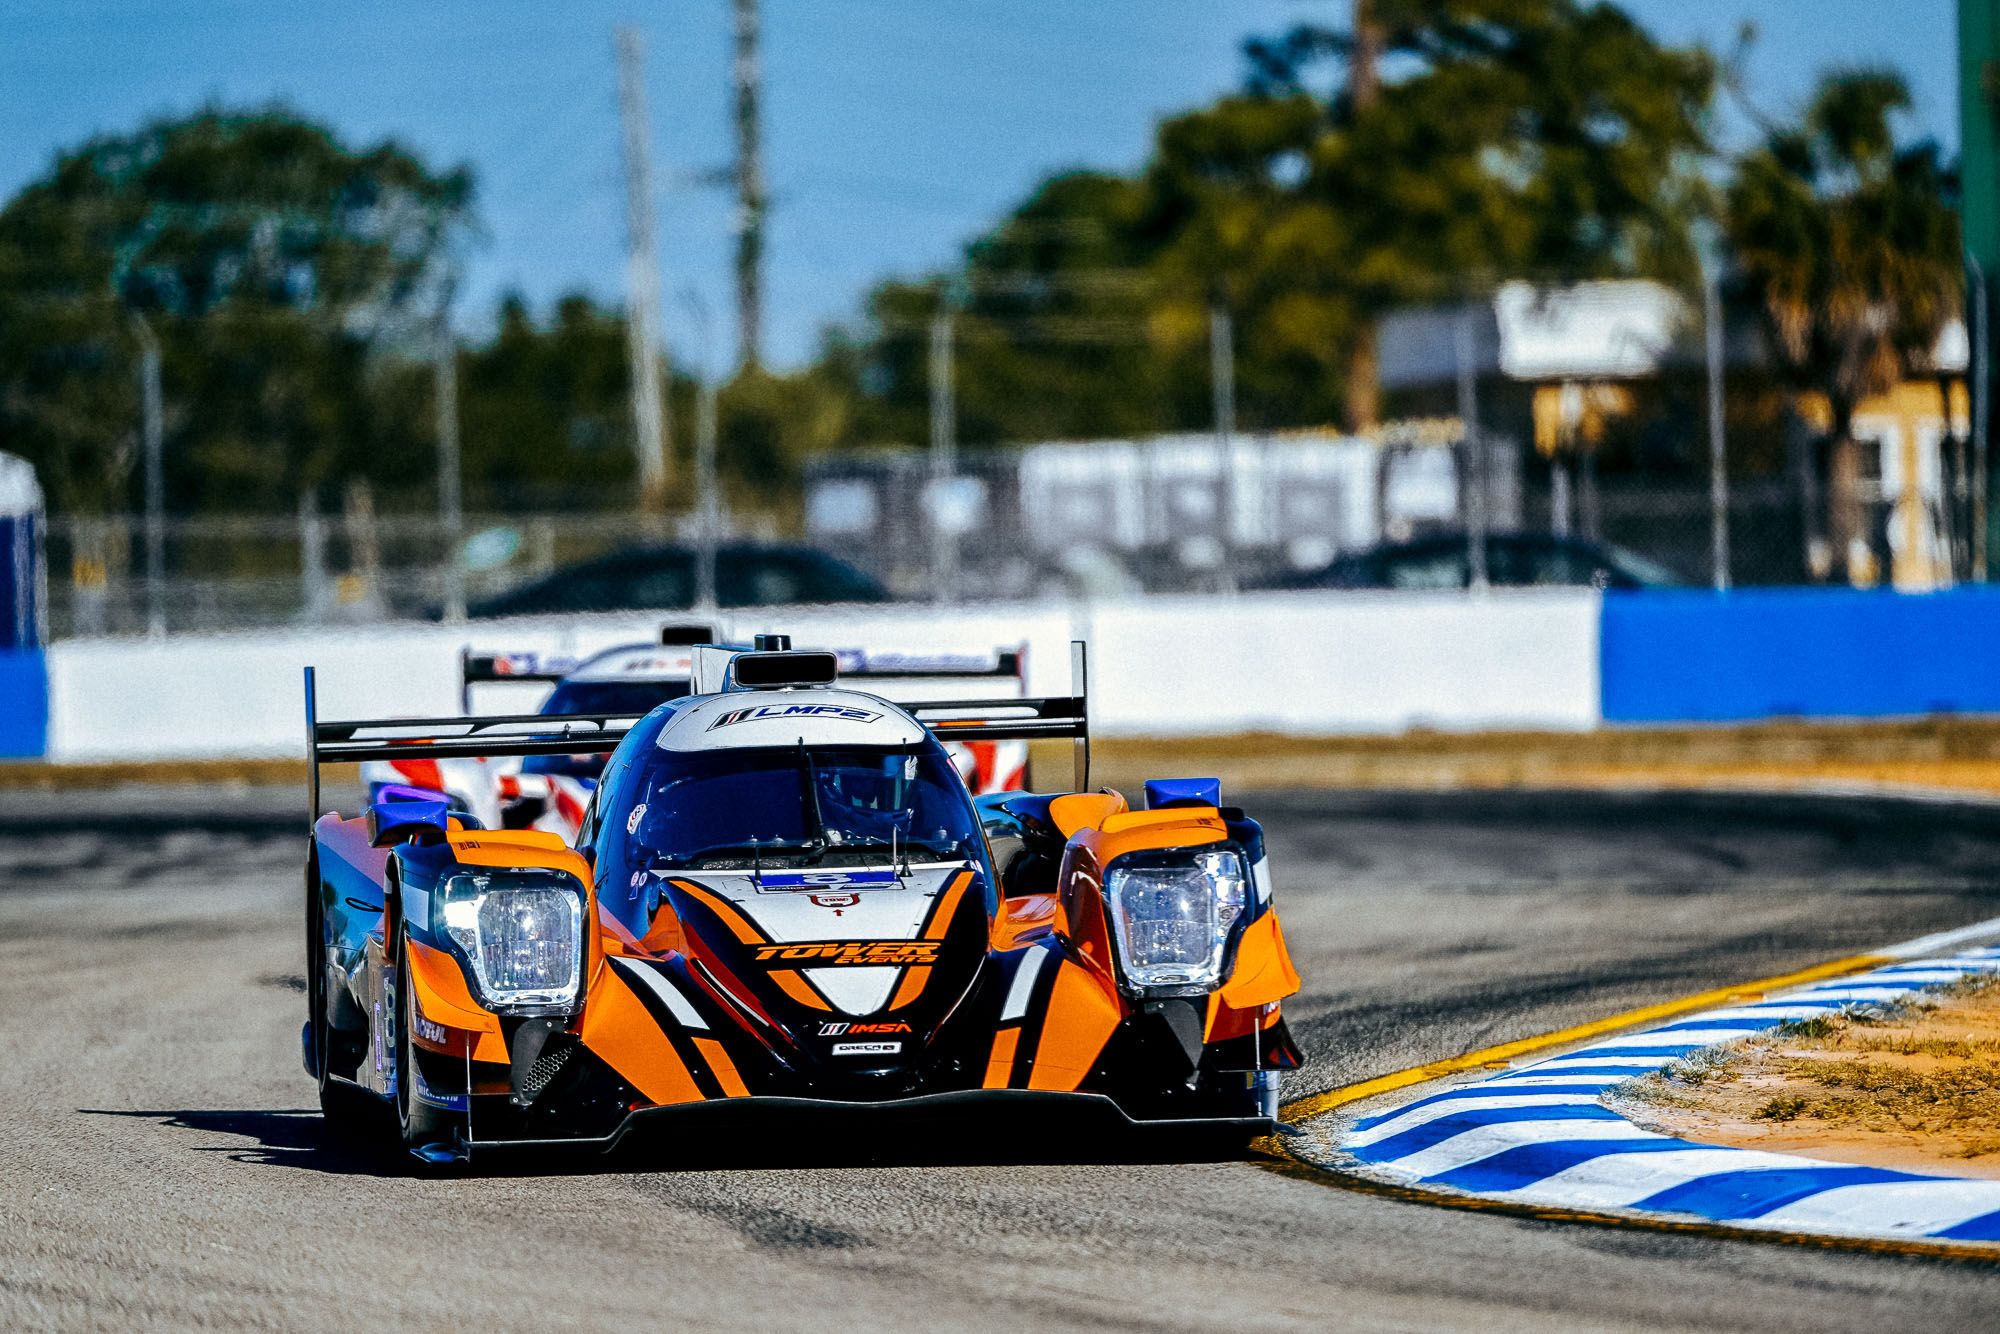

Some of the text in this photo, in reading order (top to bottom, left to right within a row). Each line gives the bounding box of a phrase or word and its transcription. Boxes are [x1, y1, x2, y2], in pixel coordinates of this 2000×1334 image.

[755, 706, 871, 719] LMP2
[802, 873, 852, 884] 8
[755, 942, 941, 960] TOWER
[834, 955, 938, 964] EVENTS
[848, 1023, 913, 1034] IMSA
[839, 1044, 881, 1052] ORECA
